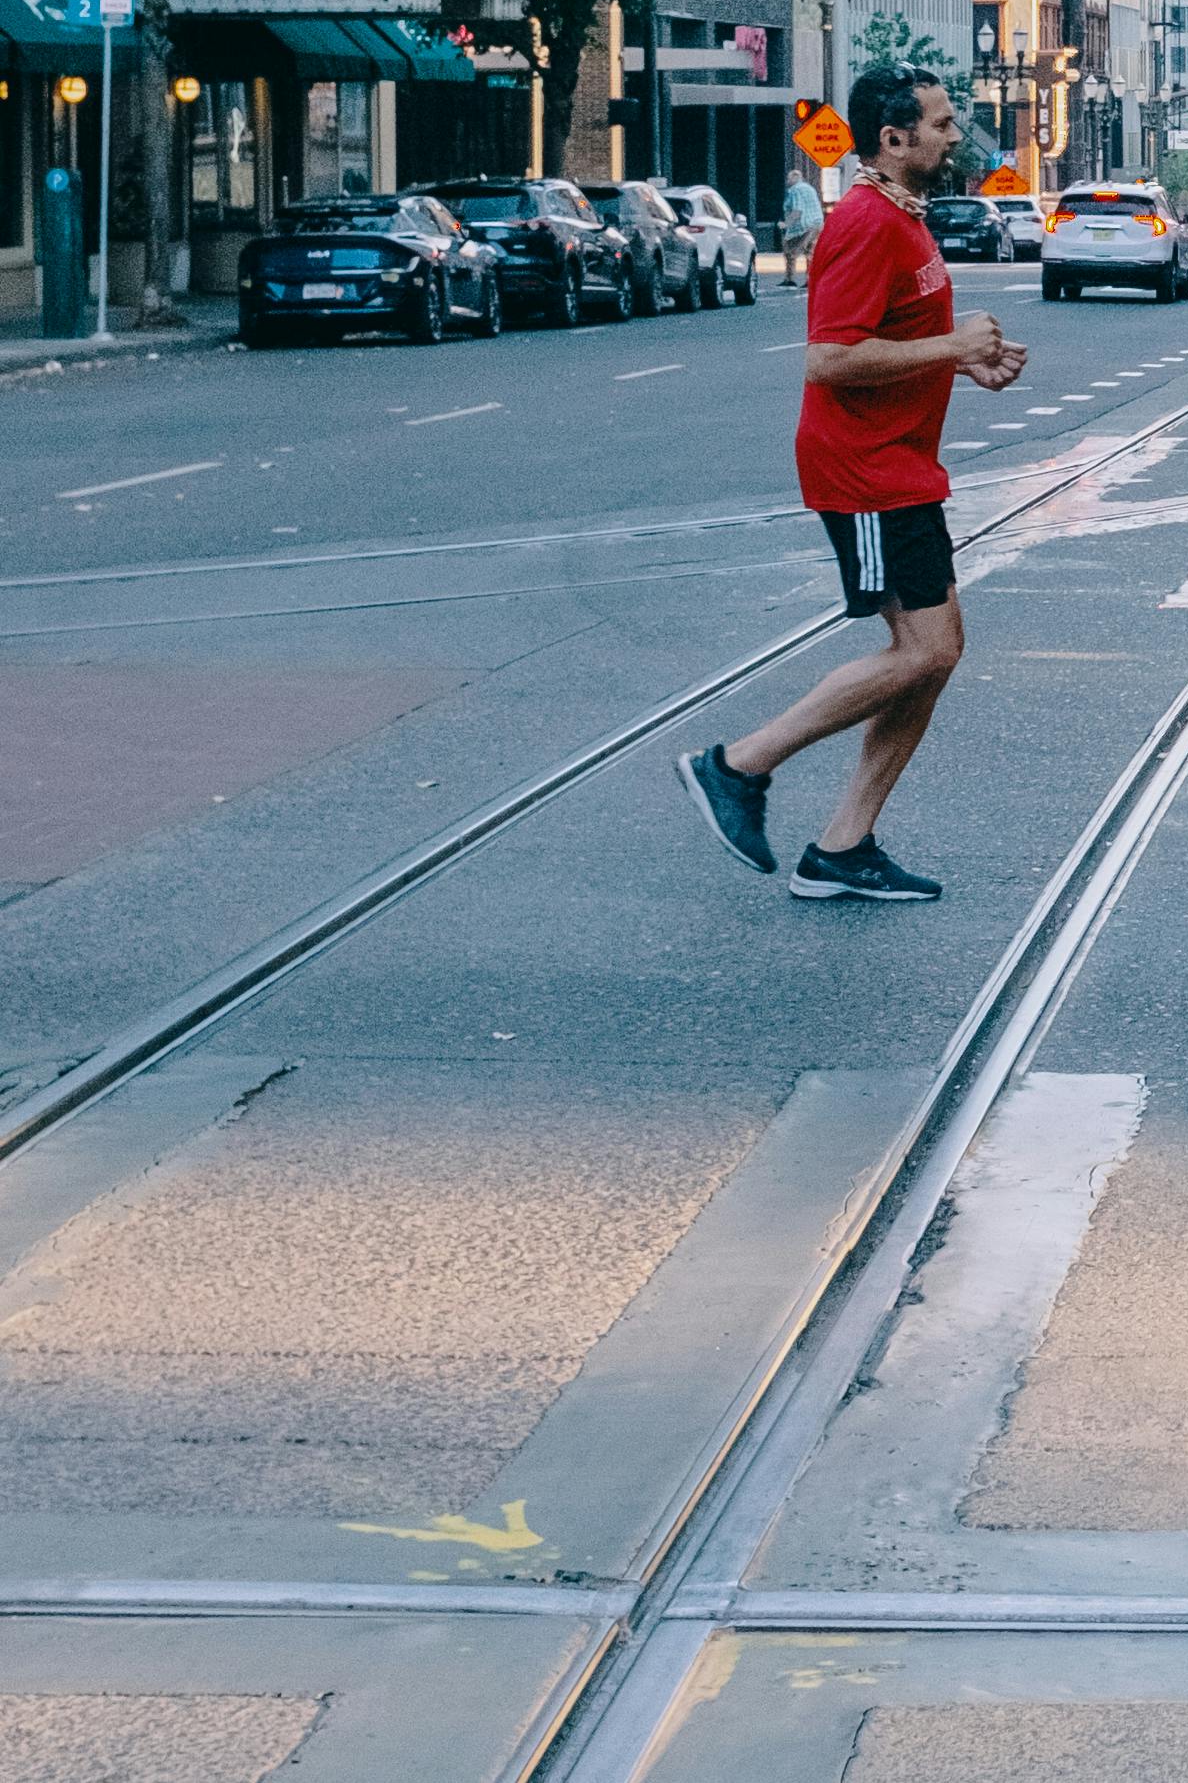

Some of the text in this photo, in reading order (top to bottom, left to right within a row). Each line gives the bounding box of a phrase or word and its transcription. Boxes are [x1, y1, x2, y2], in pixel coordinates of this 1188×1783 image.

[79, 0, 91, 18] 2
[815, 123, 840, 131] ROAD
[815, 134, 839, 142] WORK
[813, 145, 842, 154] AHEAD
